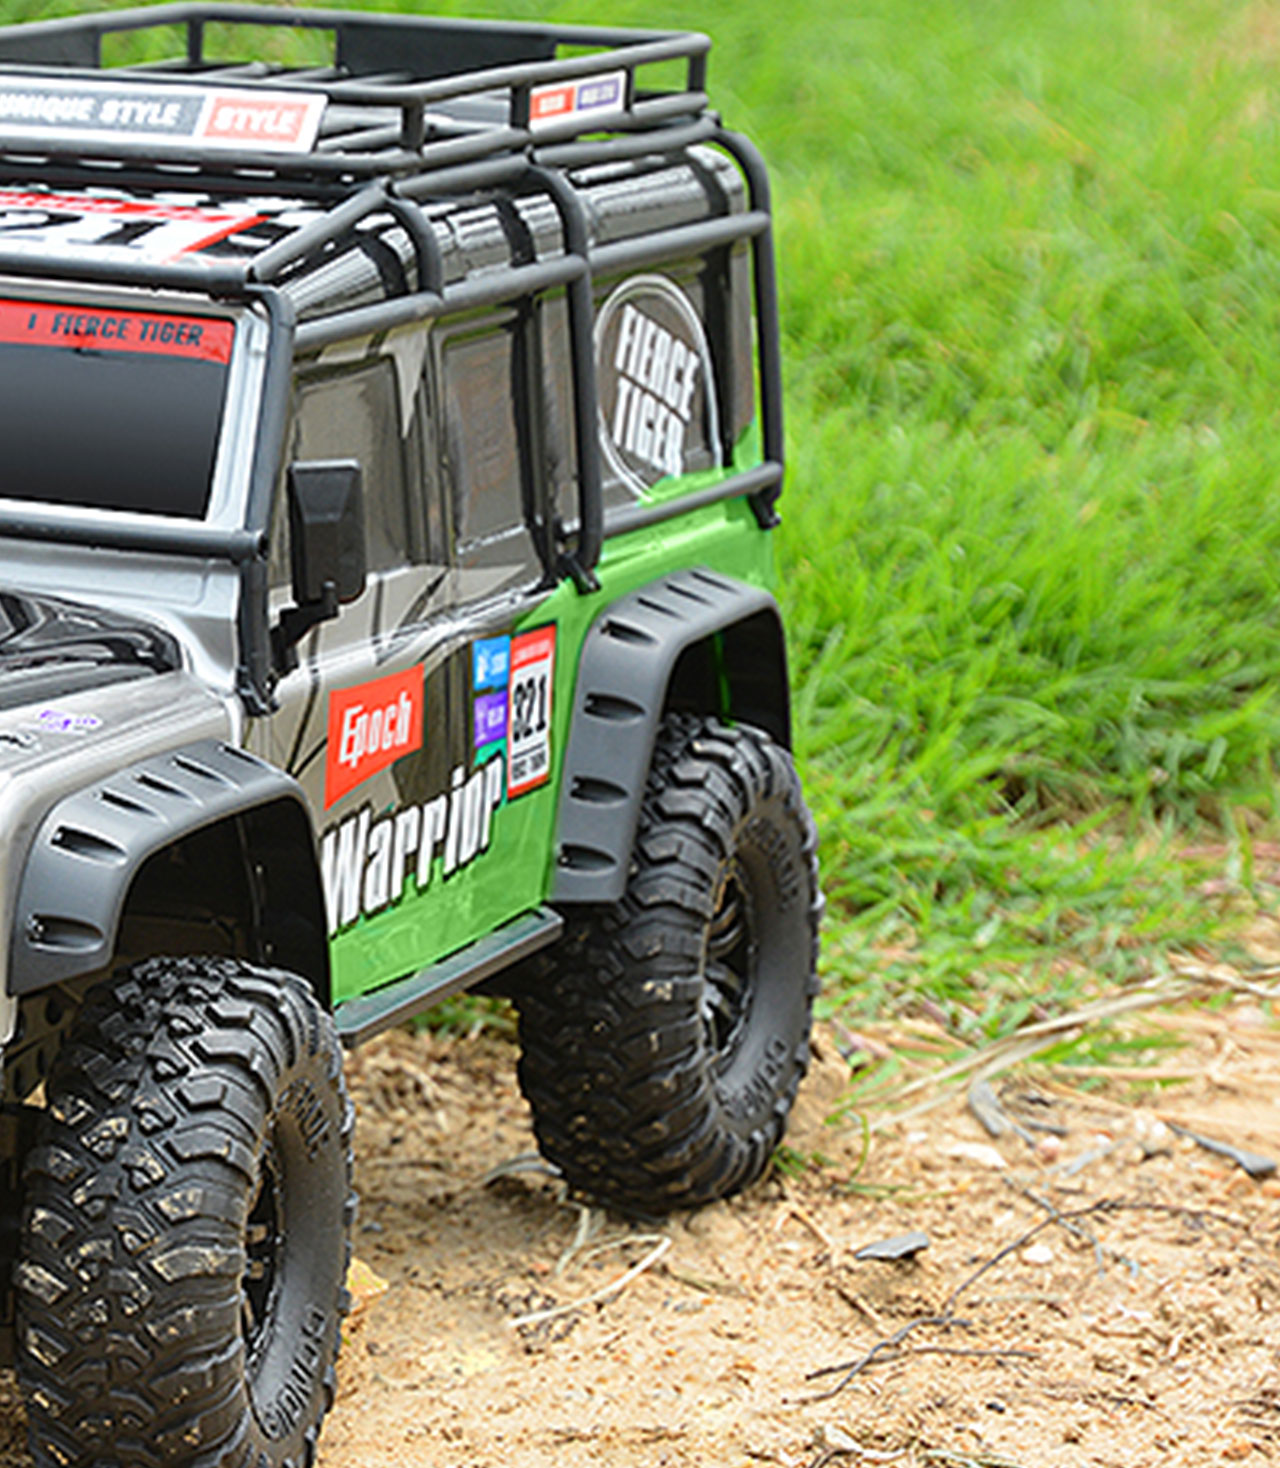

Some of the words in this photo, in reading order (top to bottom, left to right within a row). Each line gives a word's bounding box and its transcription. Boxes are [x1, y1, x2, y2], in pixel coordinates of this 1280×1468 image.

[100, 97, 181, 127] STYLE
[214, 107, 297, 135] STYLE
[51, 312, 129, 340] FIERCE
[139, 319, 204, 348] TIGER
[615, 303, 700, 422] FIERCE
[613, 374, 684, 479] TIGER
[337, 691, 412, 769] Epoch
[513, 674, 547, 742] 321
[321, 754, 504, 940] Warrior
